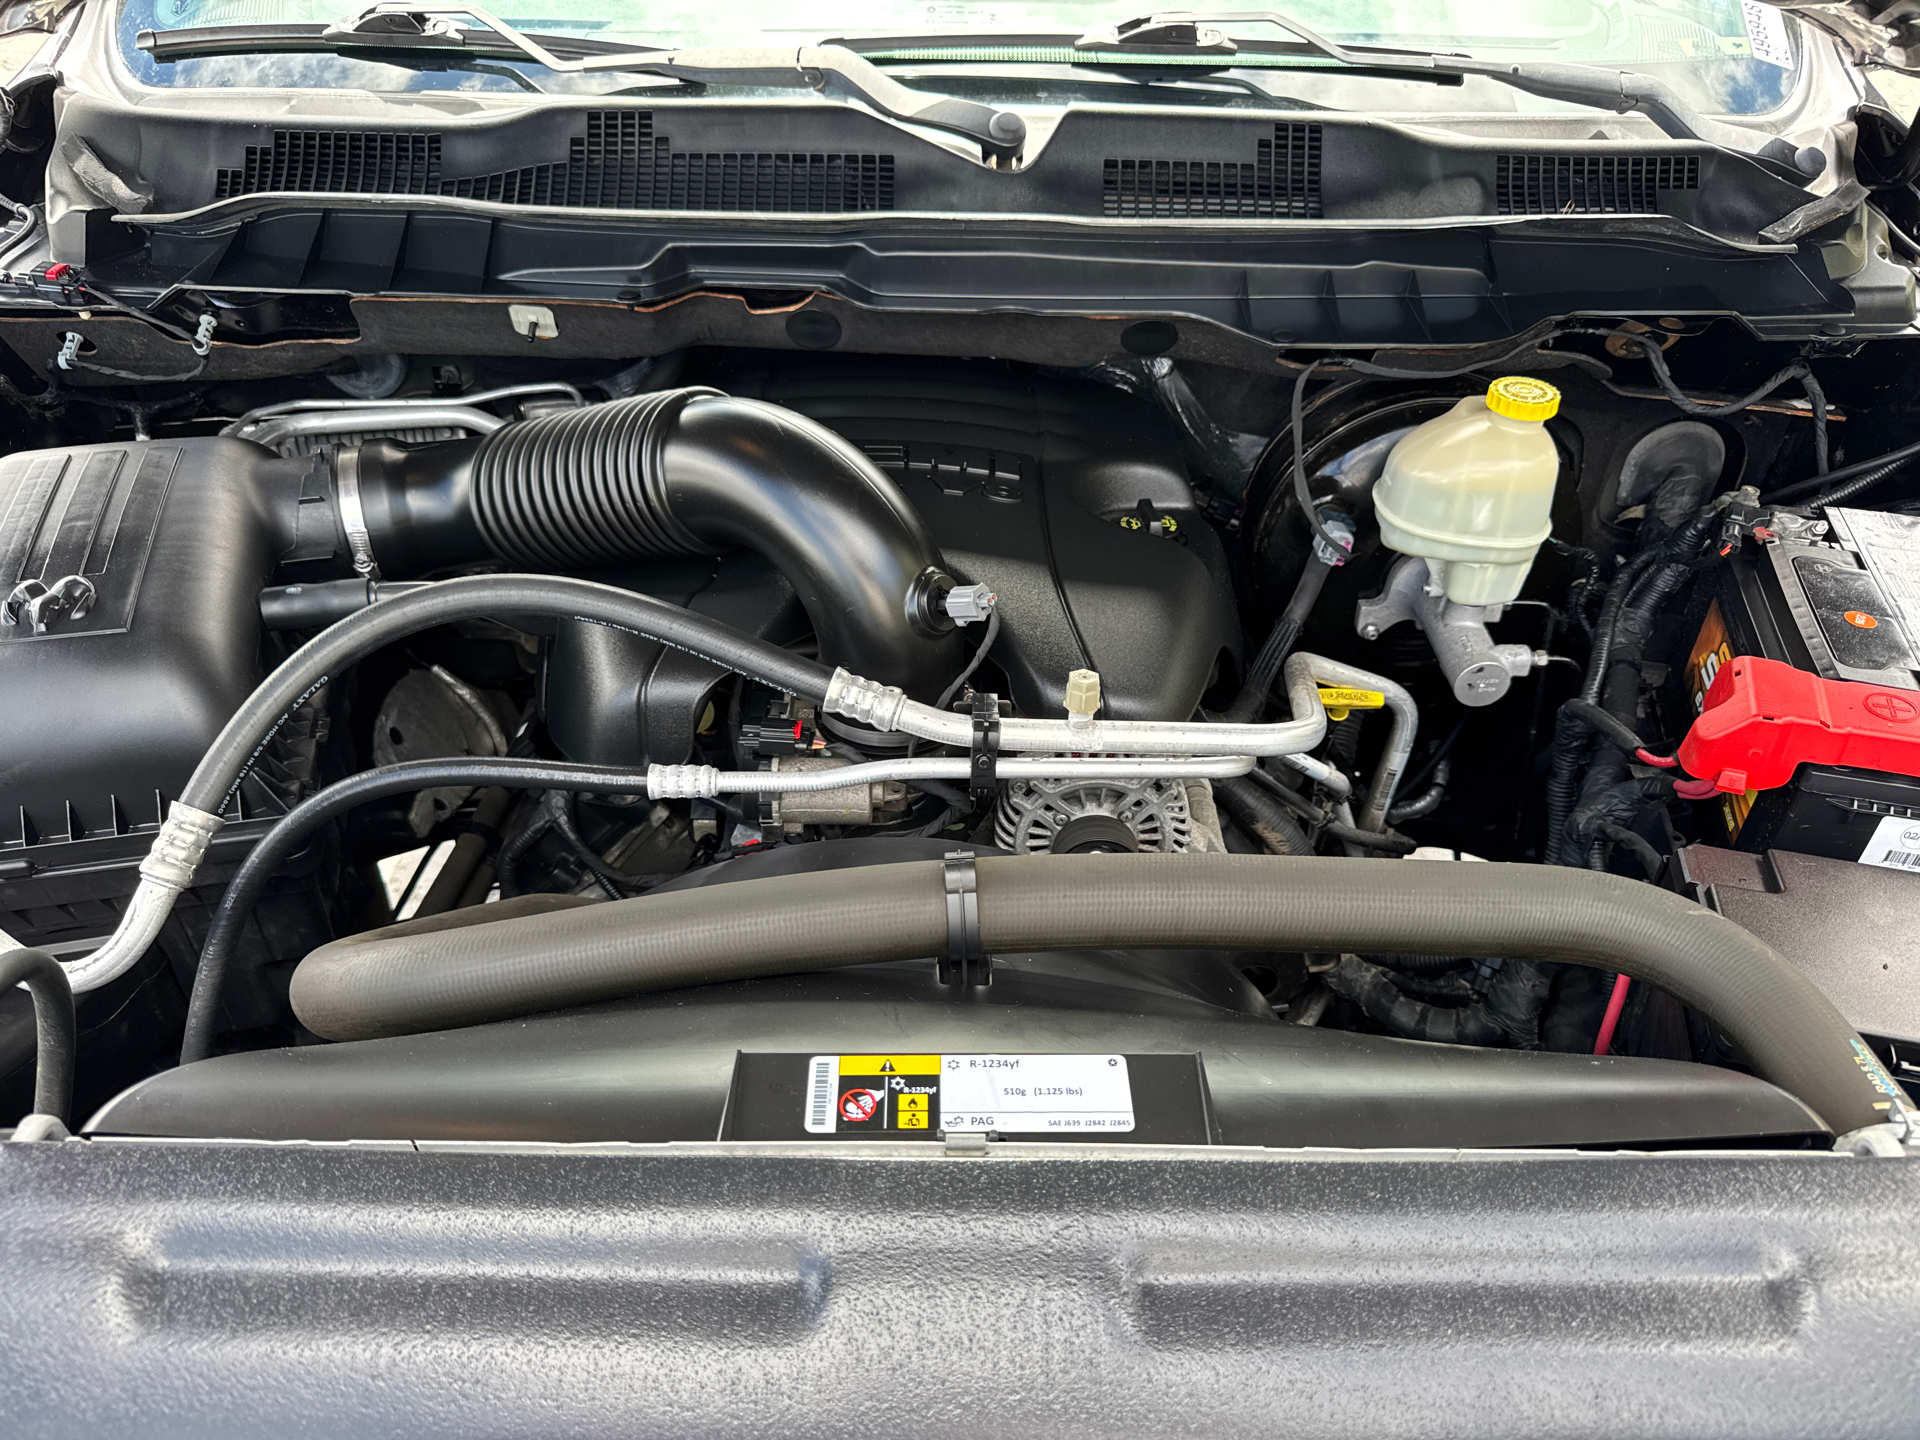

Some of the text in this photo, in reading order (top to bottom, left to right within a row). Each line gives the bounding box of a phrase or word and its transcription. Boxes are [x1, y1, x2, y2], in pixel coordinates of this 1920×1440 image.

[292, 675, 328, 711] GALAXY
[970, 1059, 1020, 1069] R-1234yf
[904, 1086, 937, 1094] R-1234yf
[1004, 1087, 1083, 1097] 510g (1.125 lbs)
[970, 1116, 994, 1126] PAG
